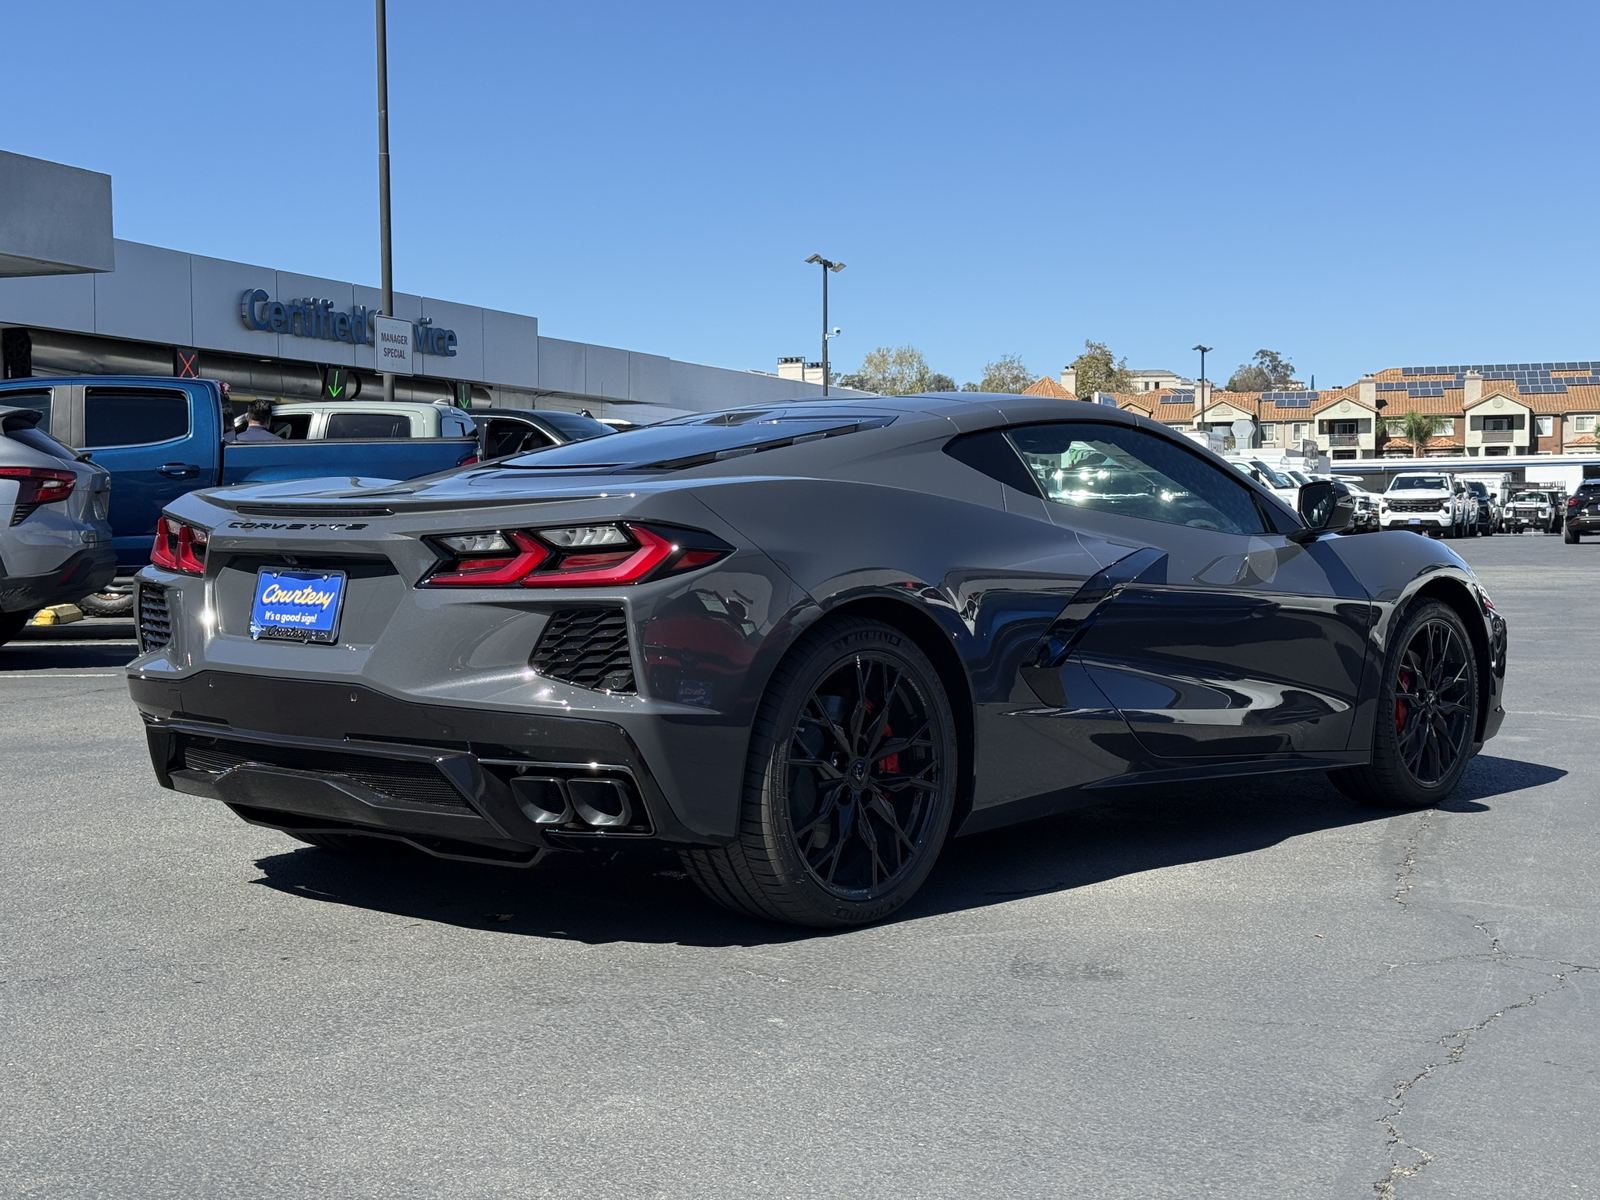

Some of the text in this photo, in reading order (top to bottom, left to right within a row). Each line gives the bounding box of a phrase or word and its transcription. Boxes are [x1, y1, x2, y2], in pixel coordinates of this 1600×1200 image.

[241, 288, 367, 345] Certified
[381, 332, 408, 346] MANAGER
[383, 347, 406, 360] SPECIAL
[227, 522, 369, 531] CORVETTE
[262, 583, 336, 611] Courtesy
[264, 610, 275, 621] It's
[281, 612, 302, 624] good
[301, 613, 318, 625] sign!
